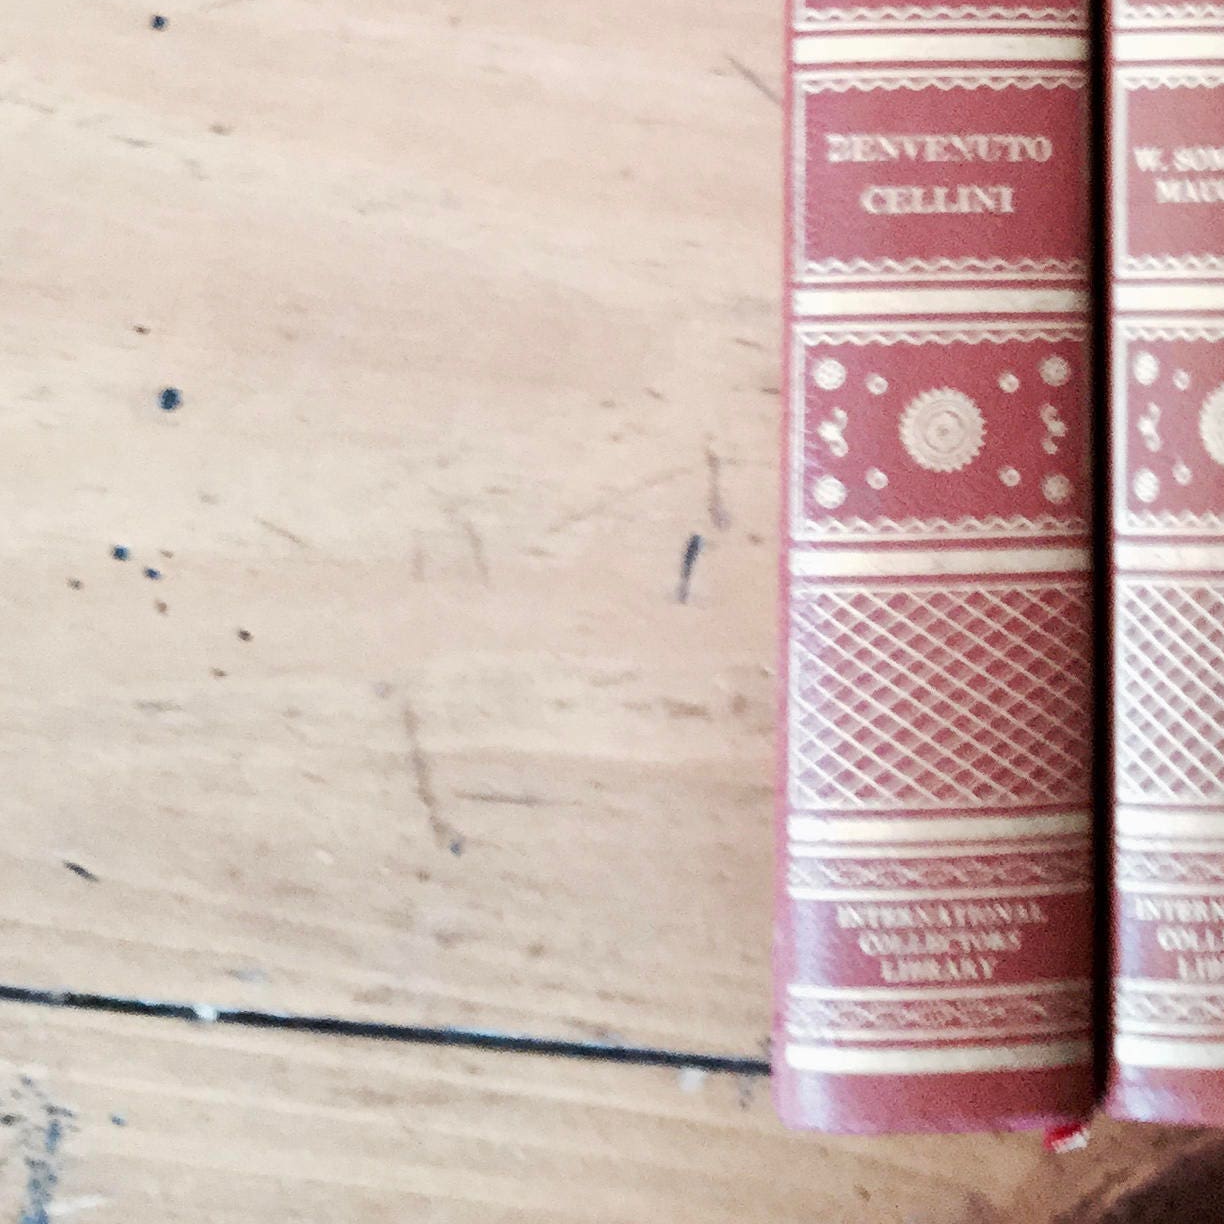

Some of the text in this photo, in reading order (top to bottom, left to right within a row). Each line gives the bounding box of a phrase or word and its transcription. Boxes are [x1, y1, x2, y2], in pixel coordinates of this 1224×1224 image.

[826, 133, 1052, 164] BENVENUTO
[1133, 147, 1167, 172] W.
[859, 184, 1014, 214] CELLINI
[836, 903, 1047, 928] INTERNATIONAL
[859, 929, 1021, 955] COLLECTORS
[880, 956, 997, 982] LIBRARY
